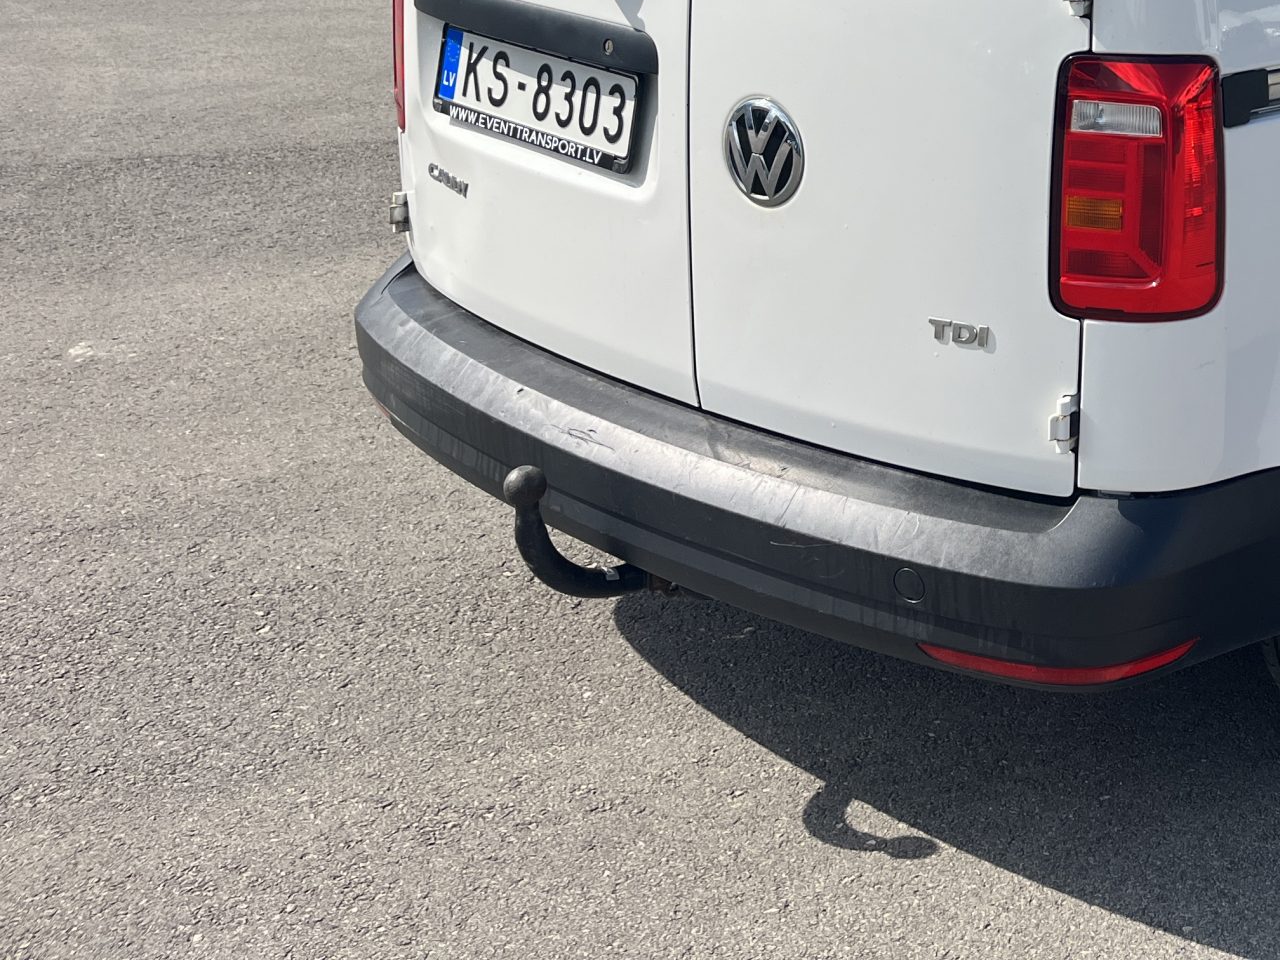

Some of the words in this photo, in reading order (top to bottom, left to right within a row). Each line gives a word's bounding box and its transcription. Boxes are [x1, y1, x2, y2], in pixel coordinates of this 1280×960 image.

[443, 70, 456, 87] LV
[461, 41, 626, 144] KS-8303
[449, 105, 603, 165] WWW.EVENTTRANSPORT.LV
[727, 99, 803, 204] VW
[928, 316, 990, 348] TDI
